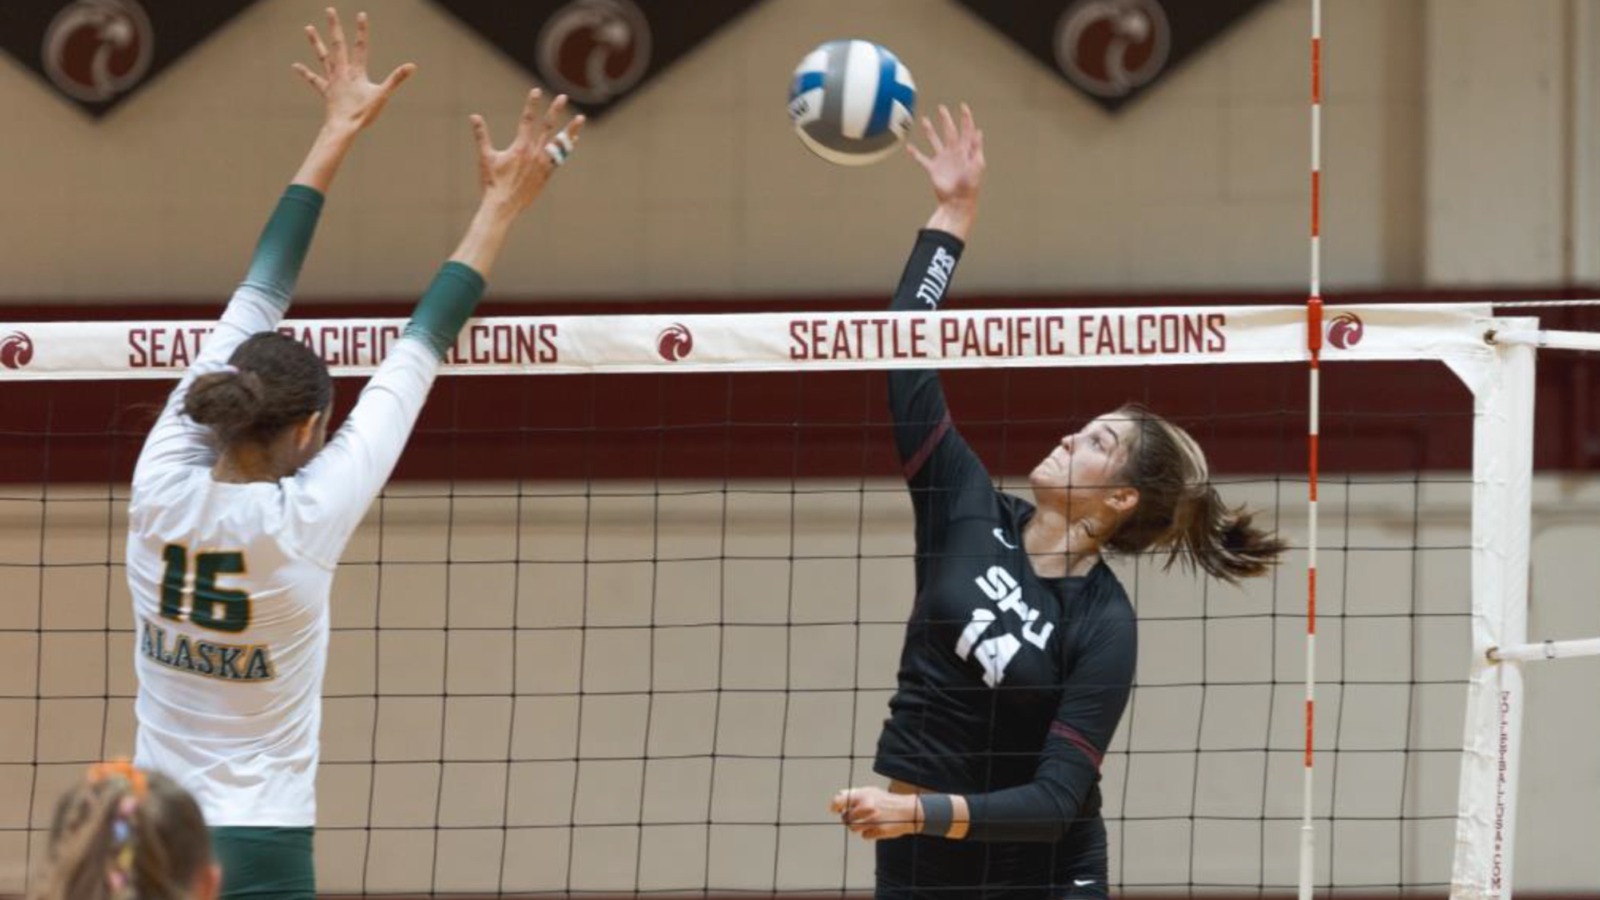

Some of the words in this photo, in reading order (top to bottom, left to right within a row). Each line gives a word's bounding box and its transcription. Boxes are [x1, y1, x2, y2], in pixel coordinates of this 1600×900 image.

[128, 328, 214, 368] SEAT
[443, 324, 558, 365] LCONS
[789, 318, 928, 360] SEATTLE
[940, 315, 1065, 358] PACIFIC
[1078, 313, 1226, 355] FALCONS
[160, 543, 252, 633] 16
[141, 617, 272, 681] ALASKA
[954, 607, 1022, 689] 14
